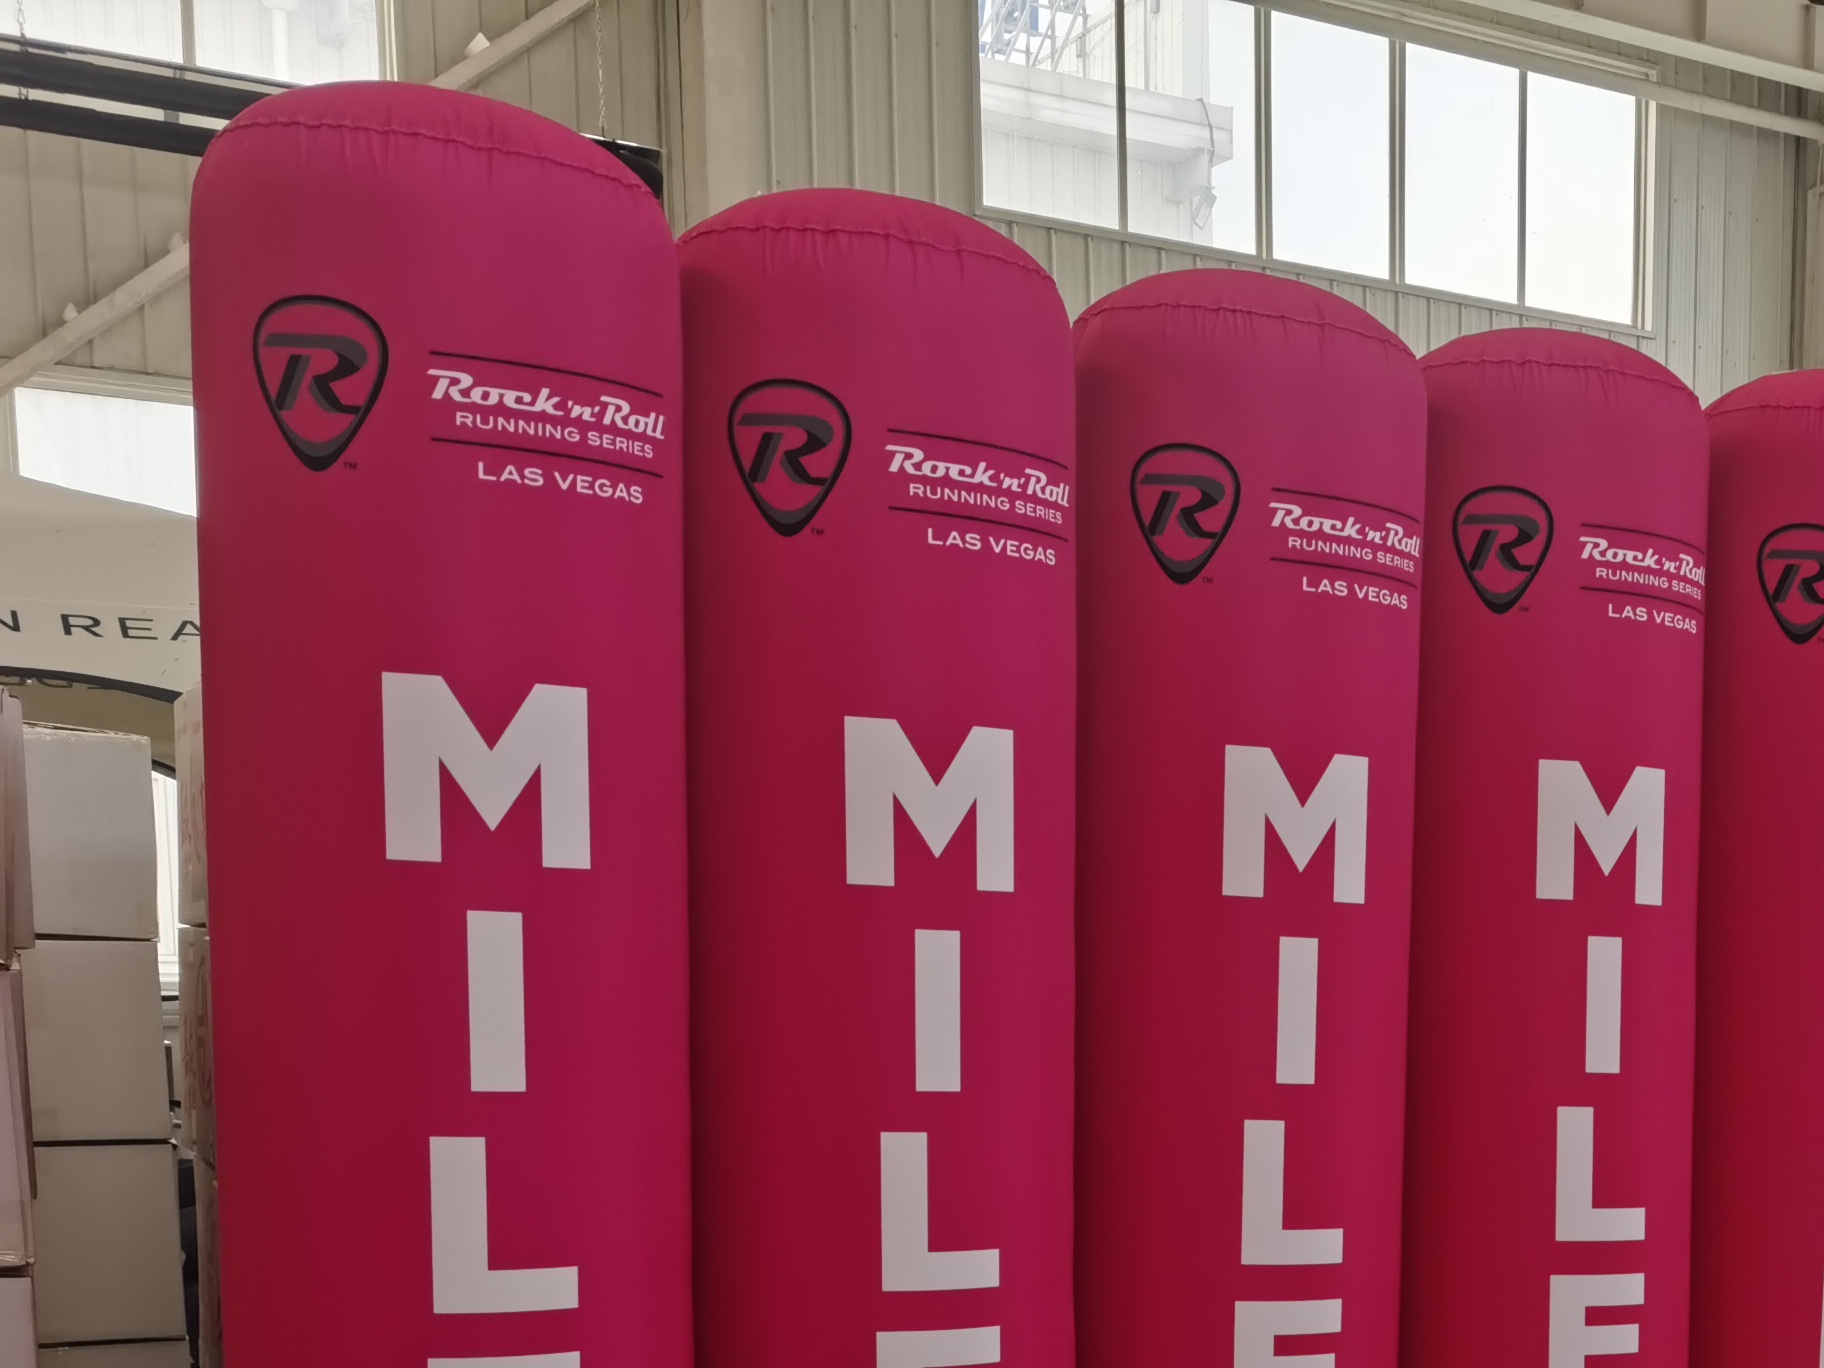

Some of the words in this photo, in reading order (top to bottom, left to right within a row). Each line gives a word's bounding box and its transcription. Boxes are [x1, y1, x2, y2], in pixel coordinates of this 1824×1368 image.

[456, 411, 580, 441] RUNNING
[587, 431, 653, 459] SERIES
[478, 461, 544, 486] LAS
[554, 471, 643, 504] VEGAS
[909, 483, 1010, 510] RUNNING
[1015, 501, 1062, 524] SERIES
[928, 528, 981, 550] LAS
[989, 536, 1056, 566] VEGAS
[1288, 537, 1372, 561] RUNNING
[1377, 551, 1414, 573] SERIES
[1302, 576, 1348, 597] LAS
[1354, 584, 1408, 610] VEGAS
[1596, 567, 1668, 588] RUNNING
[1672, 580, 1701, 600] SERIES
[1608, 603, 1648, 621] LAS
[1653, 609, 1697, 634] VEGAS
